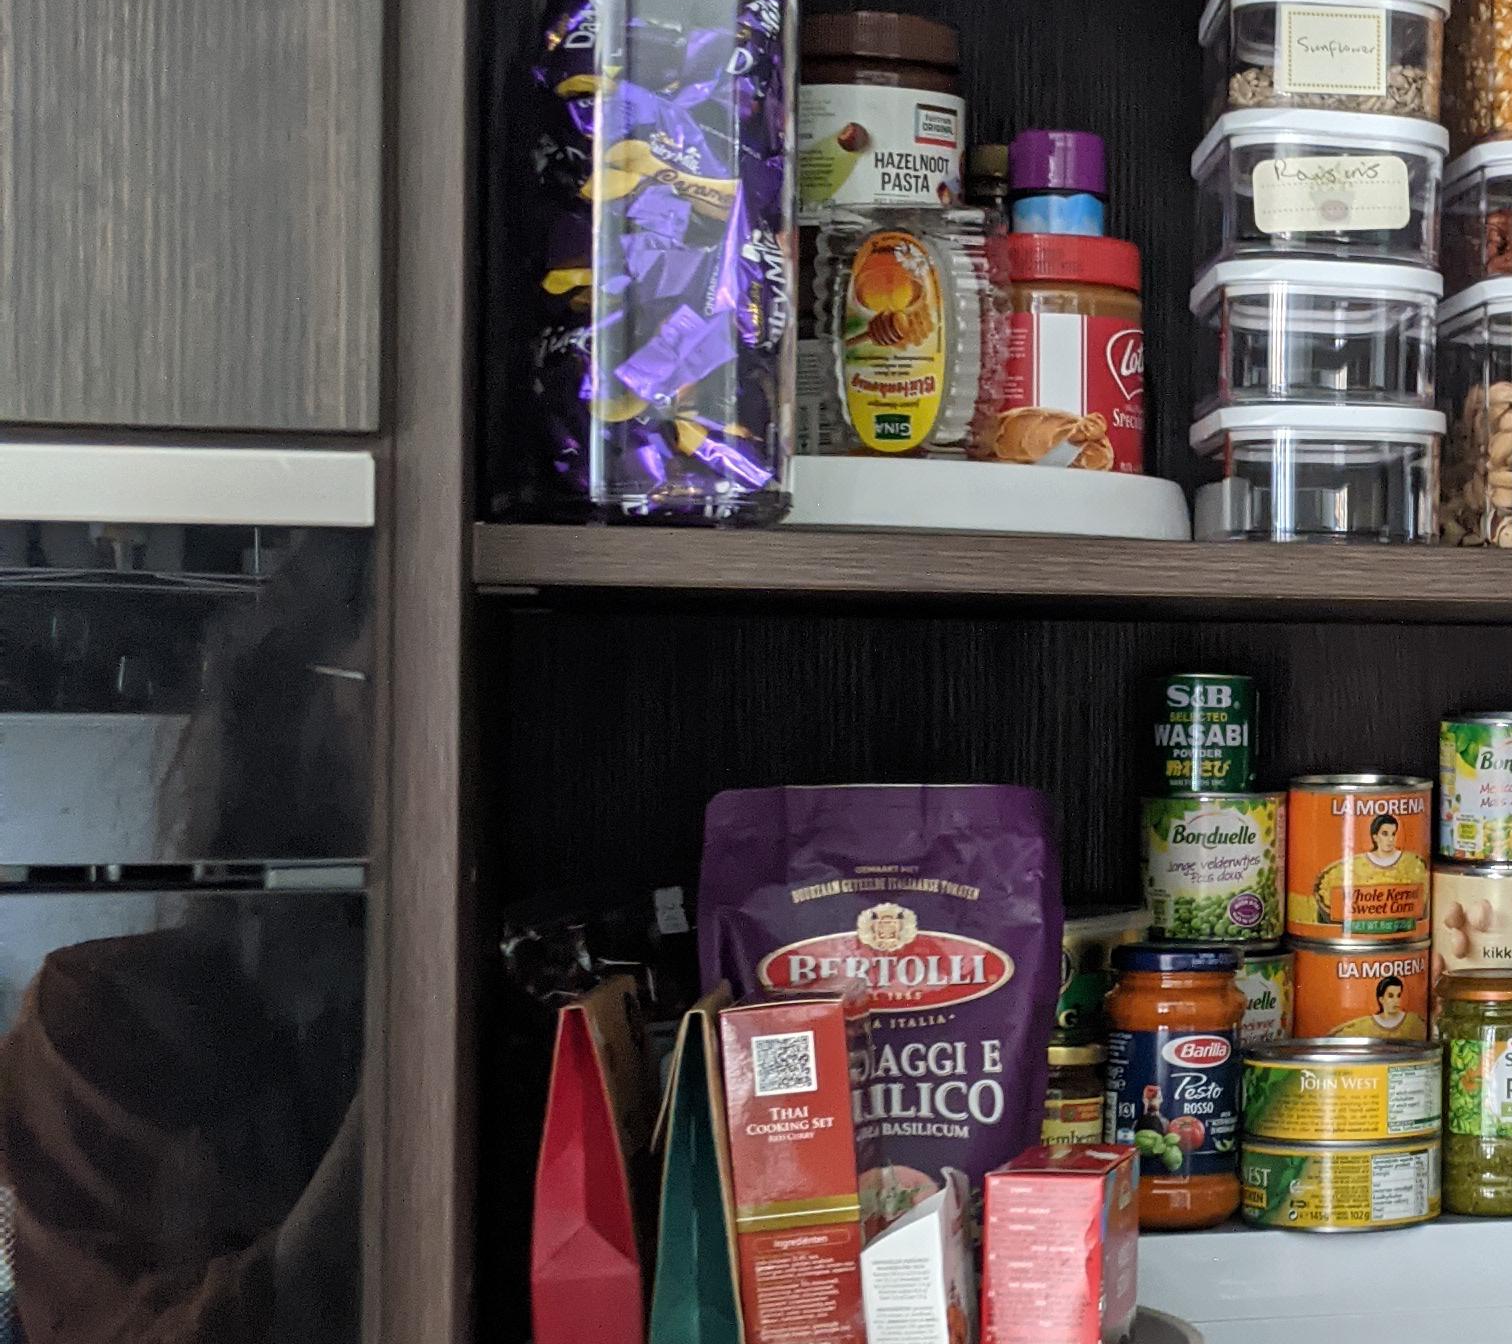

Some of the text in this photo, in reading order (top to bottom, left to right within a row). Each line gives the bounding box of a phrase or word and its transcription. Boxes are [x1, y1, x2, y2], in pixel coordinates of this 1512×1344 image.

[874, 151, 950, 177] HAZELNOOT
[881, 171, 930, 194] PASTA
[875, 422, 911, 437] GINA
[1154, 722, 1249, 747] WASABI
[1331, 797, 1426, 817] LA MORENA
[1172, 824, 1257, 850] Bonduelle
[1217, 869, 1245, 883] doux
[1389, 901, 1415, 915] Corn
[787, 954, 987, 989] BERTOLLI
[1337, 958, 1426, 980] LA MORENA
[981, 1039, 1003, 1074] E
[1180, 1042, 1227, 1059] Barilla
[1170, 1072, 1224, 1101] Pesto
[1300, 1075, 1380, 1093] JOHN WEST
[769, 1106, 809, 1121] THAI
[1183, 1102, 1214, 1115] ROSSO
[746, 1117, 835, 1136] COOKING SET
[881, 1122, 970, 1138] BASILICUM
